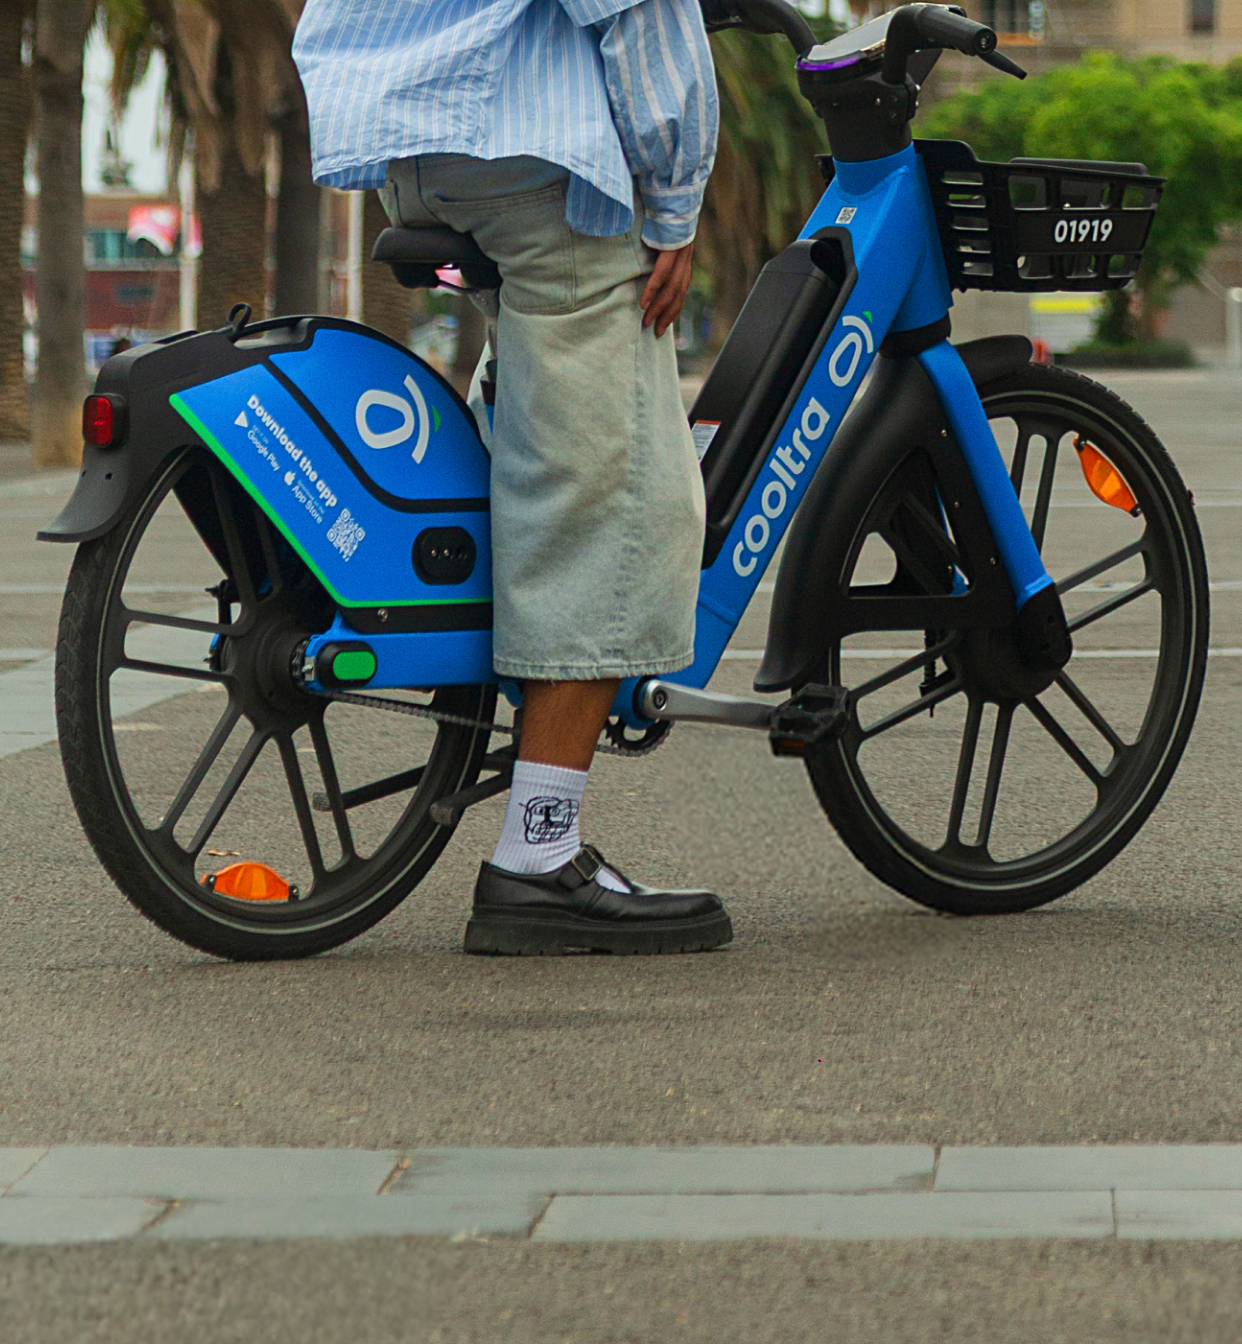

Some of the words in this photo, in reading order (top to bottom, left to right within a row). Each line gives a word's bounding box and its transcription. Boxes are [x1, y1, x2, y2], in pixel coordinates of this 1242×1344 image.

[1054, 219, 1113, 243] 01919
[247, 394, 303, 462] Download
[299, 456, 318, 482] the
[316, 479, 338, 507] app
[247, 429, 268, 458] Google
[266, 452, 281, 472] Play
[291, 485, 307, 504] App
[304, 500, 323, 524] Store
[732, 396, 831, 578] cooltra
